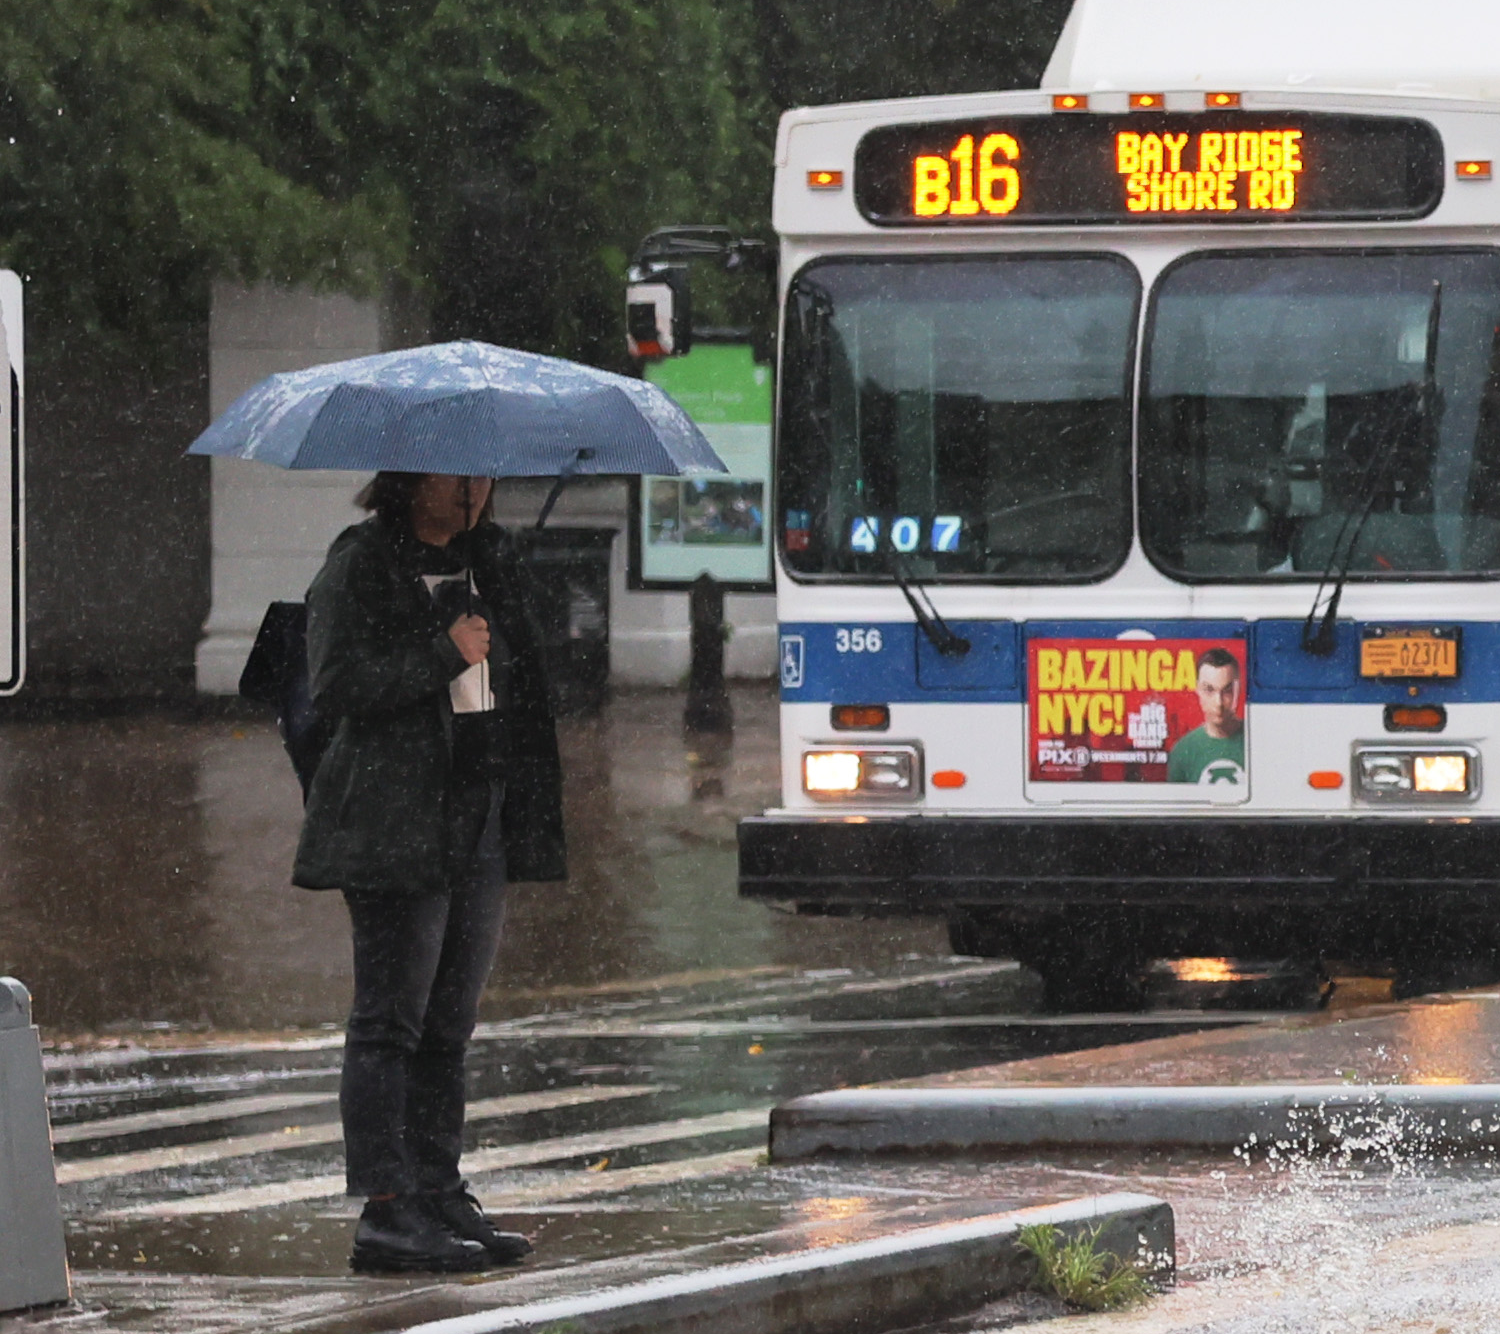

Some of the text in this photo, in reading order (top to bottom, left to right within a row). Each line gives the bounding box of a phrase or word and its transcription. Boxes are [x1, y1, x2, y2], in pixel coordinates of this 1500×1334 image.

[1116, 130, 1304, 174] BAY RIDGE
[912, 133, 1021, 216] B16
[1126, 171, 1297, 213] SHORE RD
[836, 627, 883, 653] 356
[1037, 648, 1198, 691] BAZINGA
[1037, 693, 1126, 736] NYC!
